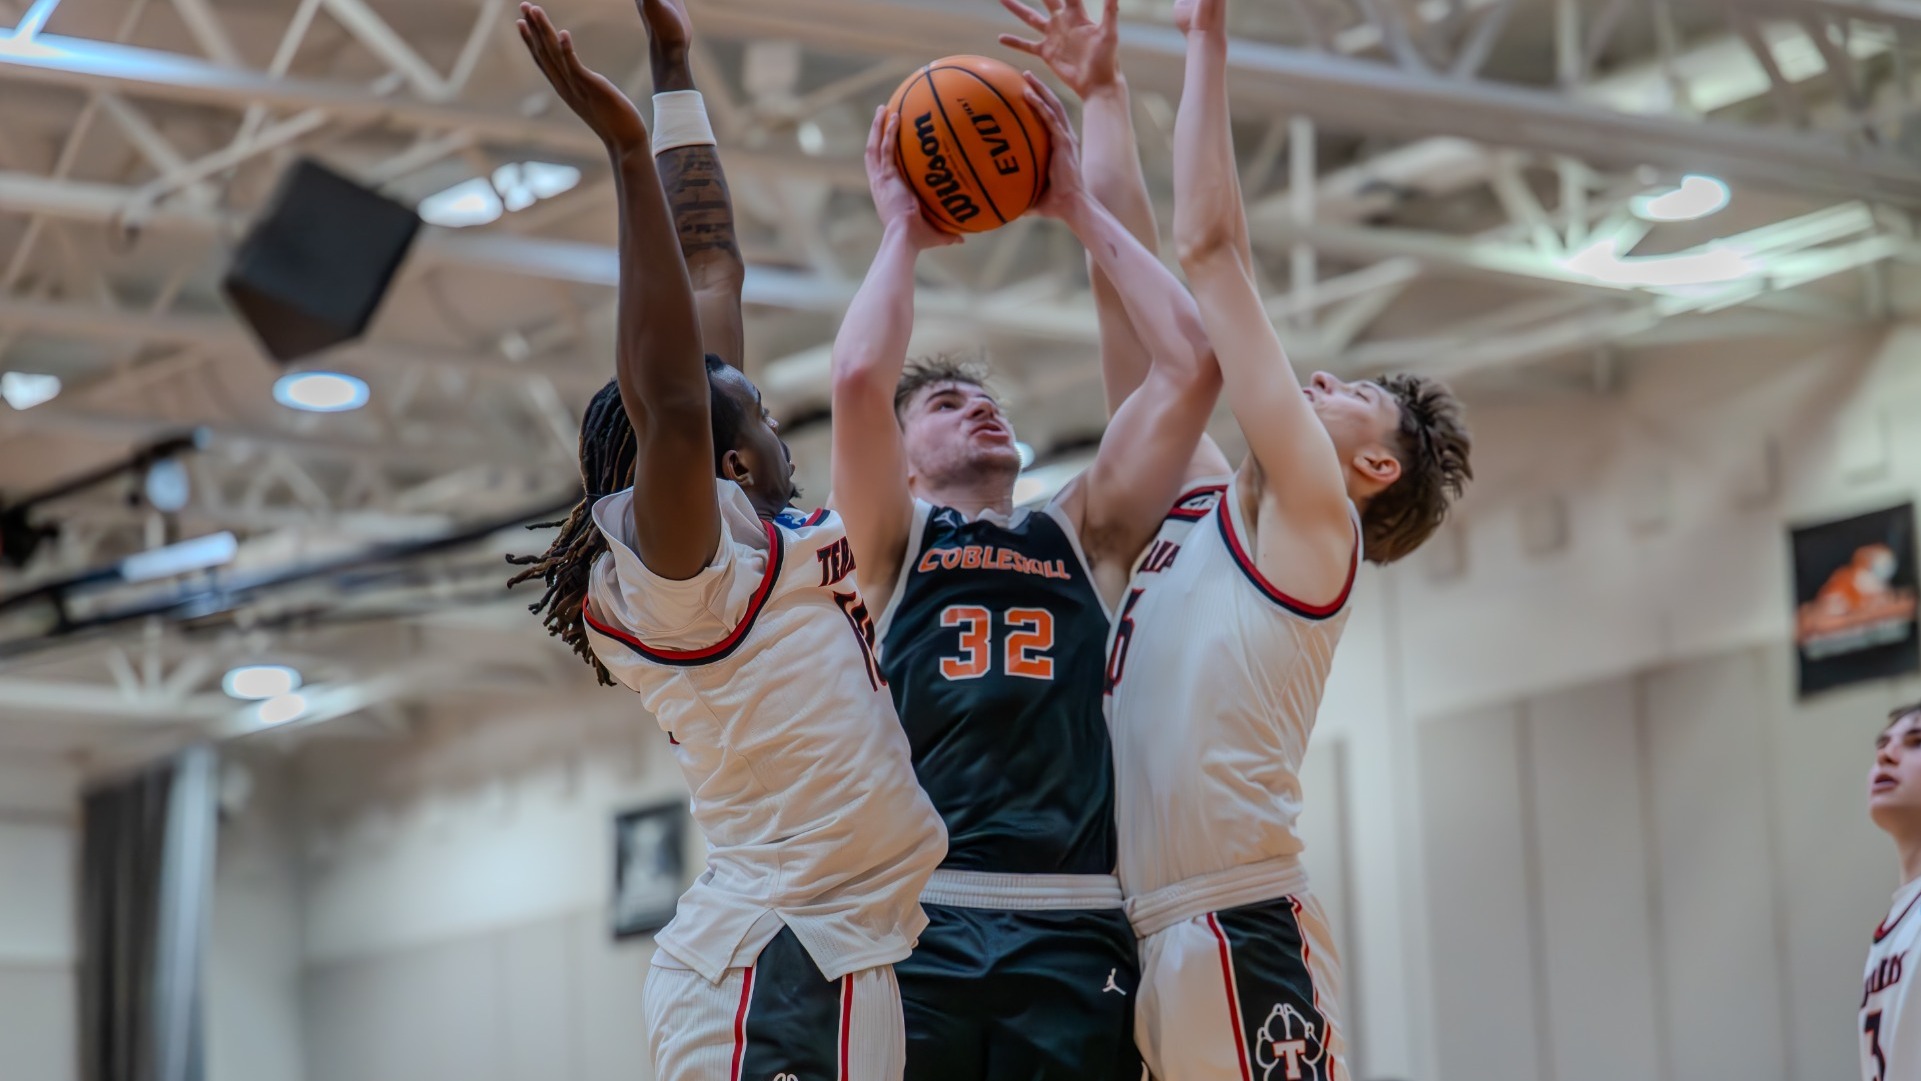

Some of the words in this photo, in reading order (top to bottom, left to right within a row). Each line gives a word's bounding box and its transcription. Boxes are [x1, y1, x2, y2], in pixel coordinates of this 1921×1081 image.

[914, 110, 980, 223] Wilson
[971, 114, 1020, 175] EVO
[917, 545, 1072, 580] COBLESKILL
[939, 604, 1055, 682] 32
[1272, 1039, 1306, 1081] T
